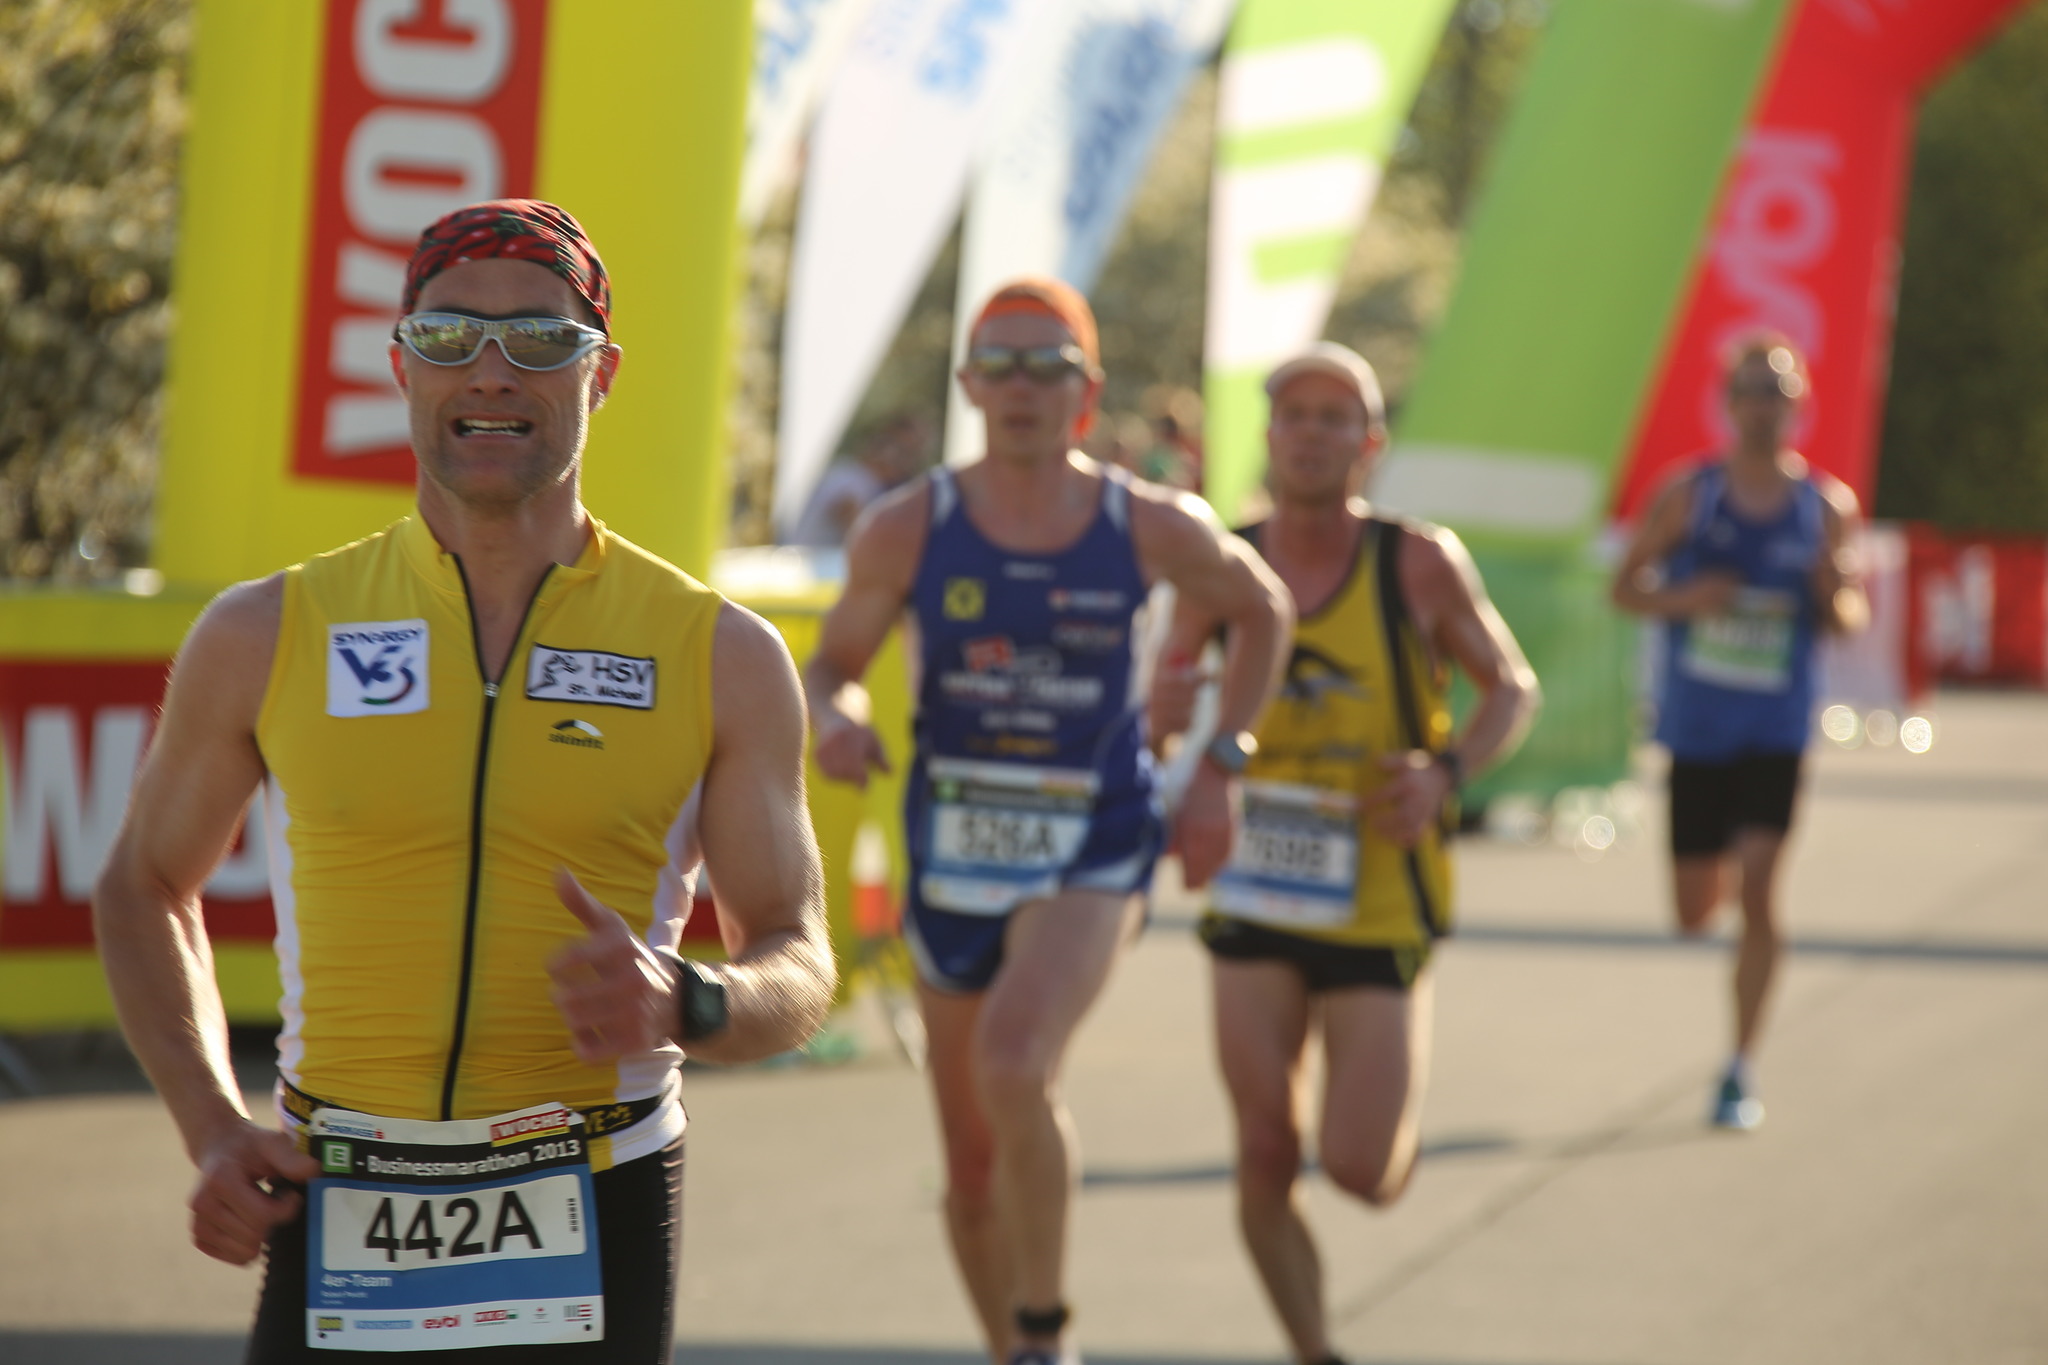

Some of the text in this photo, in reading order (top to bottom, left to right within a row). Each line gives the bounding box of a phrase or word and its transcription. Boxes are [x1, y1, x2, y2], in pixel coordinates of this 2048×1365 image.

[591, 655, 652, 685] HSV
[497, 1111, 567, 1137] WOCHE
[367, 1151, 531, 1177] Businessmarathon
[533, 1139, 581, 1162] 2013
[365, 1191, 544, 1263] 442A
